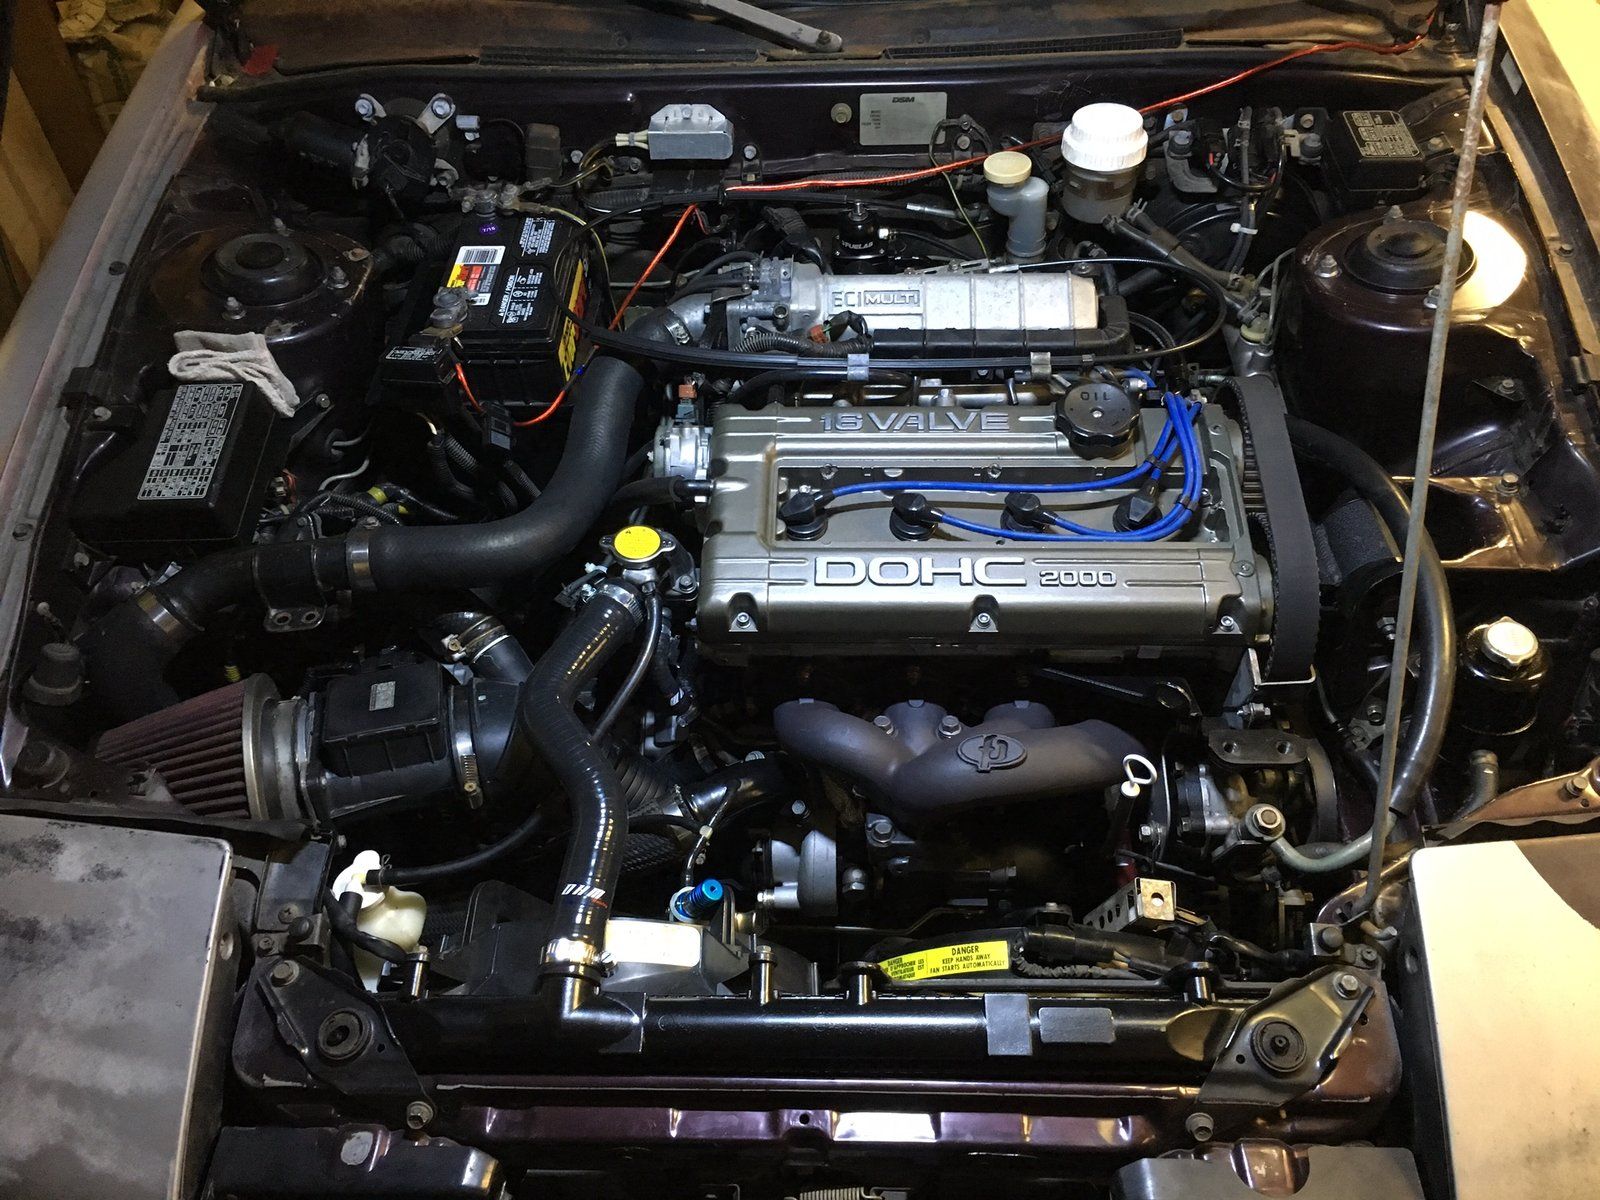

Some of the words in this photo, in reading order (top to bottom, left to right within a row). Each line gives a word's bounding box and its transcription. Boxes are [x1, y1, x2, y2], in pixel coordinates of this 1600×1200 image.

[832, 291, 862, 307] ECI
[865, 293, 919, 305] MULTI
[1080, 391, 1112, 402] OIL
[814, 556, 1027, 587] DOHC
[1039, 569, 1117, 587] 2000
[951, 945, 980, 956] DANGER
[942, 957, 954, 965] KEEP
[956, 955, 973, 963] HANDS
[975, 953, 991, 961] AWAY
[942, 963, 960, 972] STARTS
[962, 960, 1005, 969] AUTOMATICALLY
